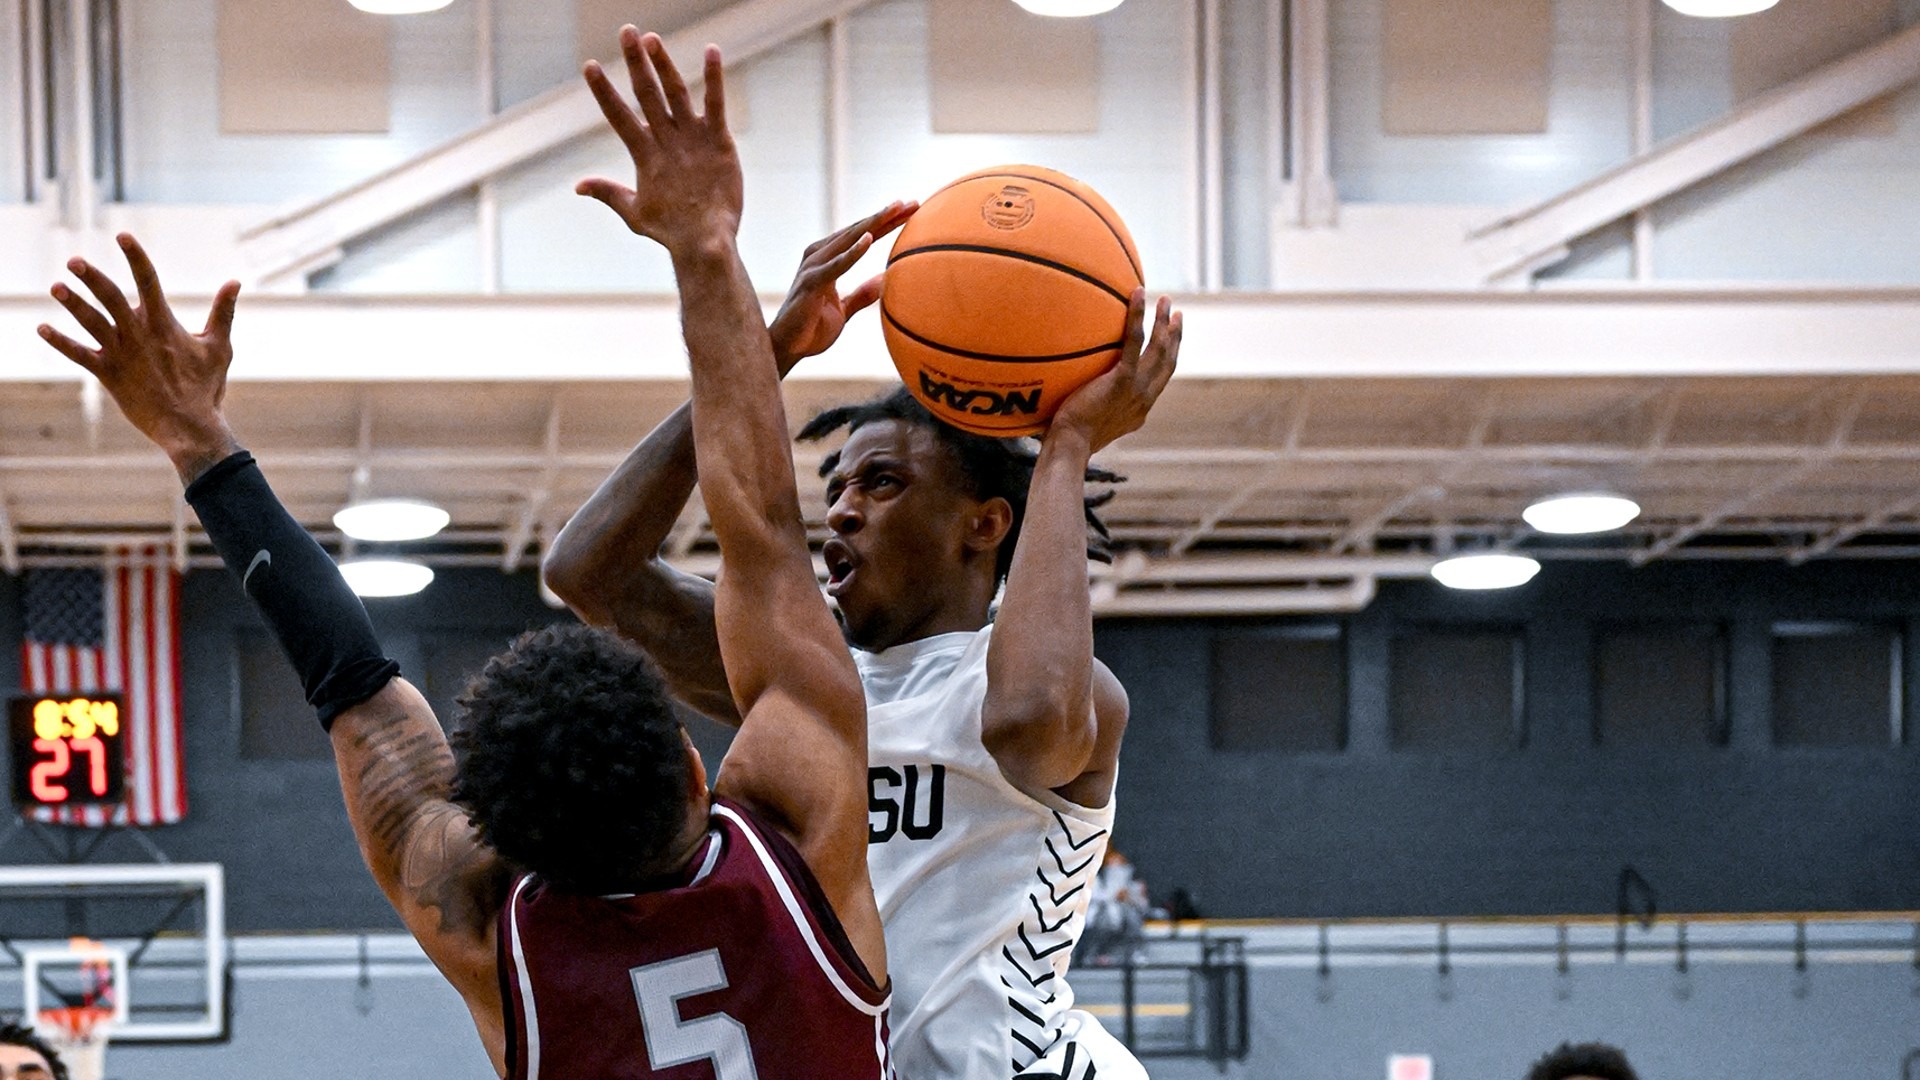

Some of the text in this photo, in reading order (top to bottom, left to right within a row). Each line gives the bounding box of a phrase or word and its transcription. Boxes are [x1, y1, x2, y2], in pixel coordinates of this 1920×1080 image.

[919, 370, 1042, 415] NCAA
[30, 737, 107, 802] 27
[629, 947, 758, 1080] 5
